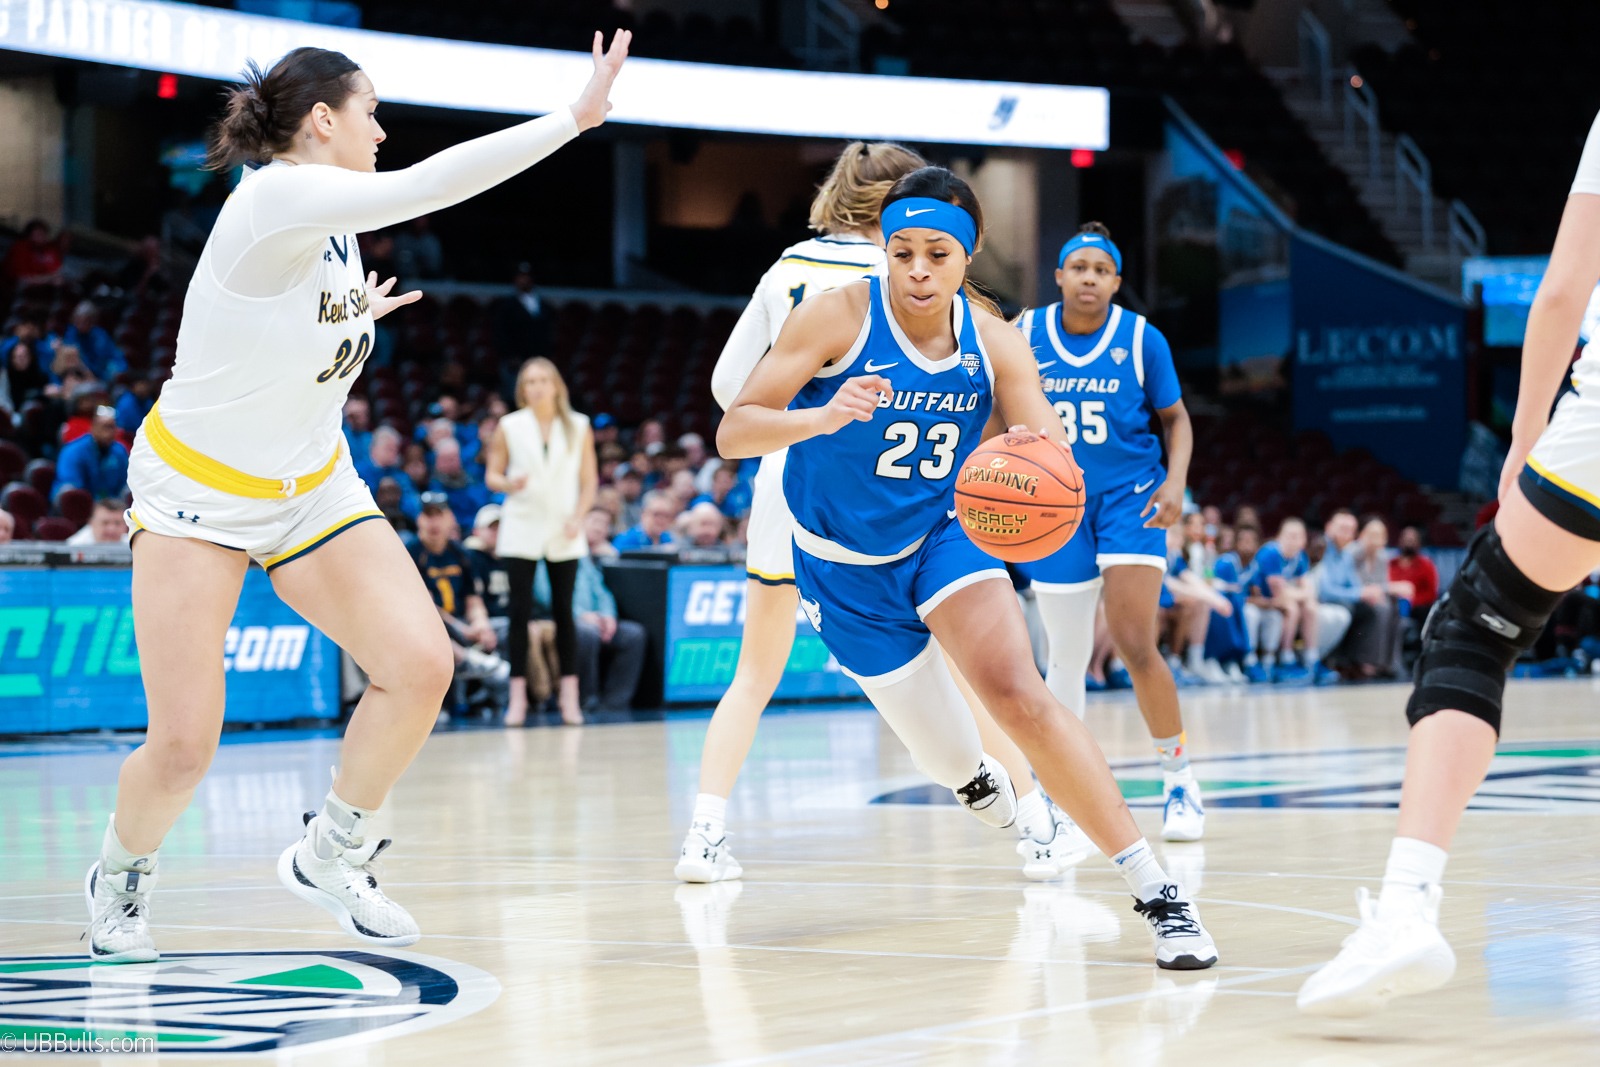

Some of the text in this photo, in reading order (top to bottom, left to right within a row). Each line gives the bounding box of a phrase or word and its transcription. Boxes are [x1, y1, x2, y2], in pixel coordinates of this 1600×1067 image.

[318, 291, 349, 324] Kent
[316, 332, 370, 384] 30
[1297, 323, 1459, 365] LECOM
[961, 360, 981, 368] MAC
[876, 390, 978, 412] BUFFALO
[1043, 377, 1120, 394] BUFFALO
[1053, 400, 1108, 445] 35
[874, 420, 961, 480] 23
[961, 465, 1039, 498] SPALDING
[960, 503, 1029, 527] LEGACY
